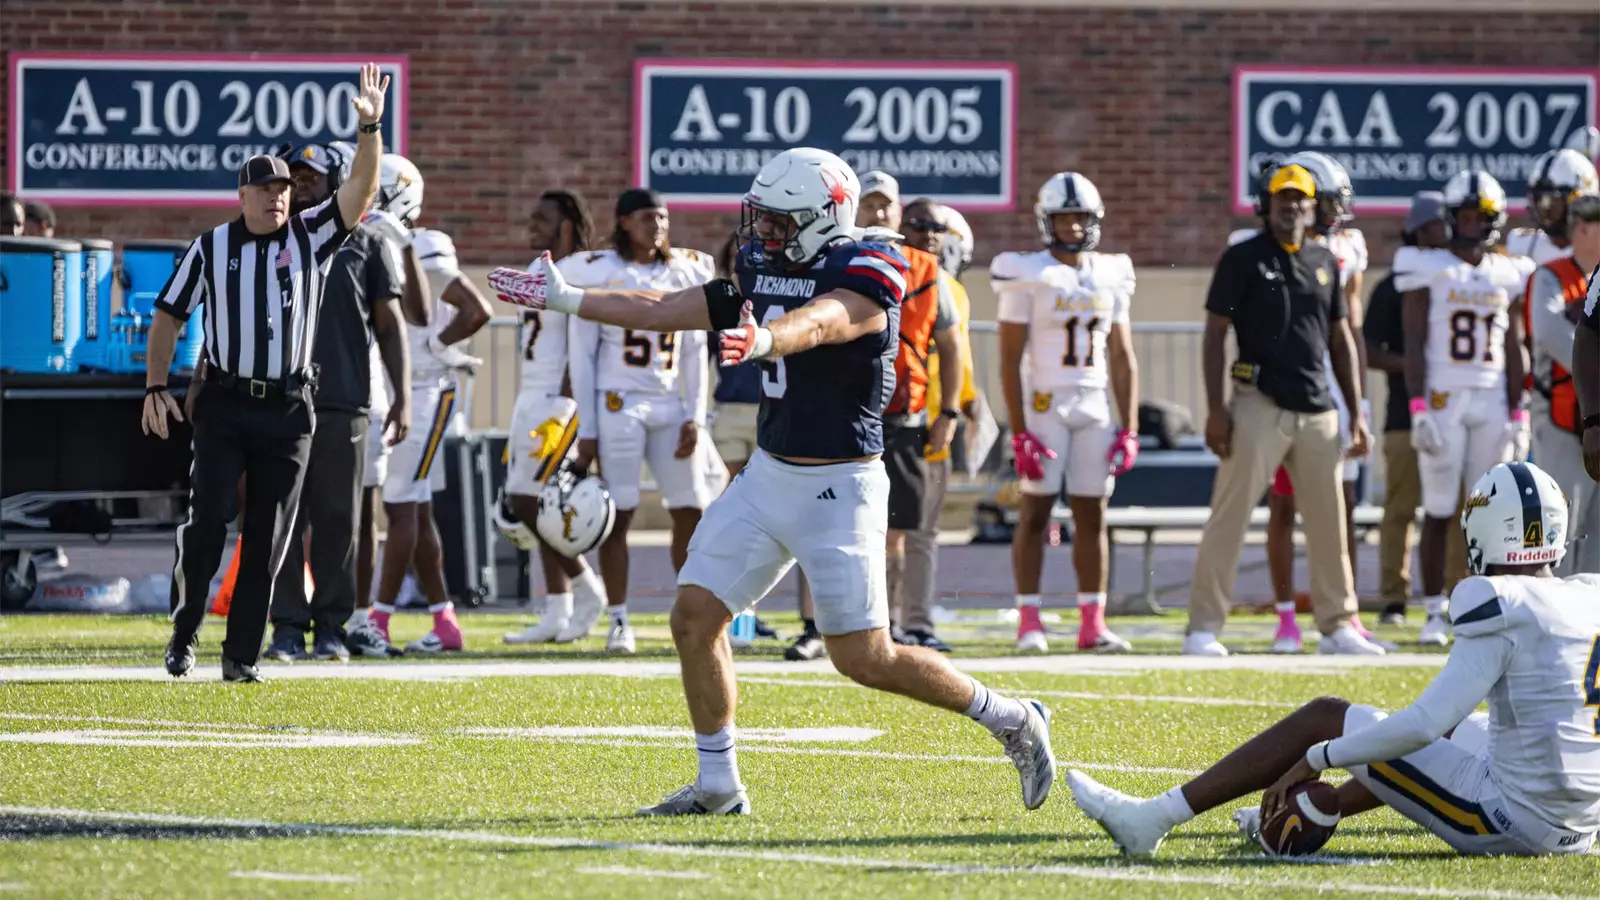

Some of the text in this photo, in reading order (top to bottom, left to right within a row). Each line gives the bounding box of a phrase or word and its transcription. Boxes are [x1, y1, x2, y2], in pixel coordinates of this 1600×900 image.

[56, 77, 359, 138] A-10 2000
[671, 84, 983, 144] A-10 2005
[1256, 89, 1581, 148] CAA 2007
[26, 142, 216, 171] CONFERENCE
[650, 148, 777, 176] CONFER
[753, 274, 816, 298] RICHMOND
[1061, 315, 1100, 367] 11
[1449, 309, 1497, 363] 81
[1523, 520, 1543, 547] 4
[1507, 548, 1556, 562] Riddell
